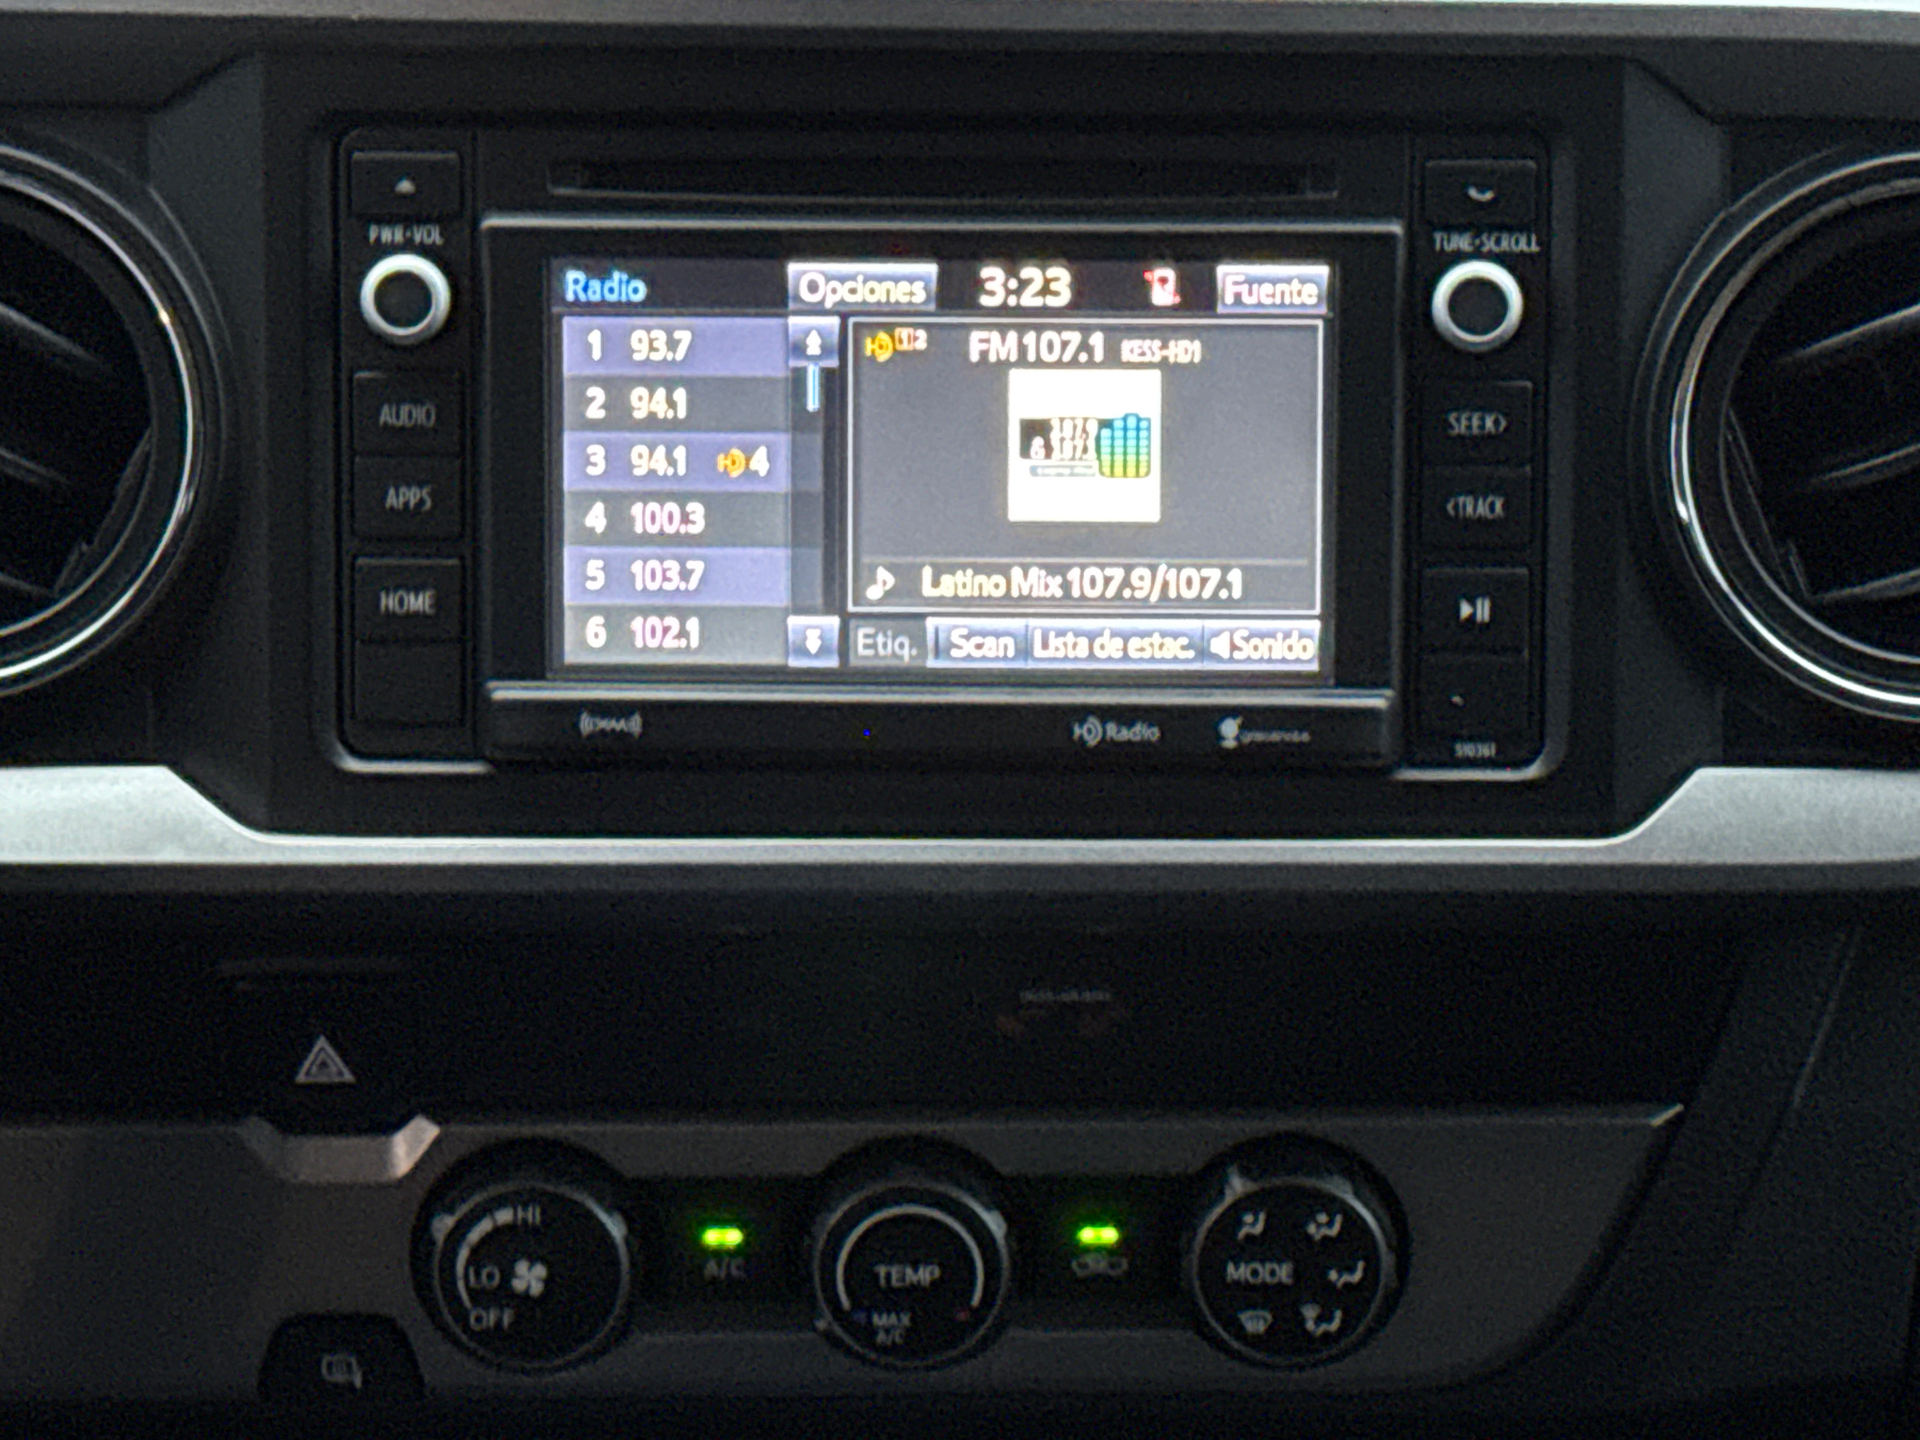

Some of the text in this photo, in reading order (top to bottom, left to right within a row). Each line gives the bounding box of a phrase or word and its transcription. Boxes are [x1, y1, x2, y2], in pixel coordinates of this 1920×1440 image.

[564, 269, 647, 304] Radio
[798, 274, 927, 309] Opciones
[978, 266, 1073, 307] 3:23
[1224, 275, 1318, 307] Fuente
[588, 329, 693, 361] 1 93.7
[968, 330, 1202, 364] FM 107.1 KESS-HD1
[379, 404, 437, 428] AUDIO
[586, 387, 687, 420] 2 94.1
[586, 444, 606, 476] 3
[630, 444, 687, 476] 94.1
[385, 487, 432, 511] APPS
[585, 501, 706, 535] 4 100.3
[586, 559, 705, 592] 5 103.7
[921, 564, 1243, 604] Latino Mix 107.9/107.1
[380, 590, 436, 615] HOME
[586, 616, 701, 649] 6 102.1
[856, 628, 918, 662] Etiq.
[949, 628, 1016, 660] Scan
[1033, 629, 1195, 661] Lista de estac.
[1233, 628, 1316, 662] Sonido
[1105, 721, 1161, 743] Radio
[517, 1204, 543, 1228] HI
[469, 1265, 502, 1291] LO
[873, 1263, 942, 1288] TEMP
[1225, 1260, 1295, 1286] MODE
[469, 1307, 517, 1332] OFF
[872, 1311, 913, 1329] MAX
